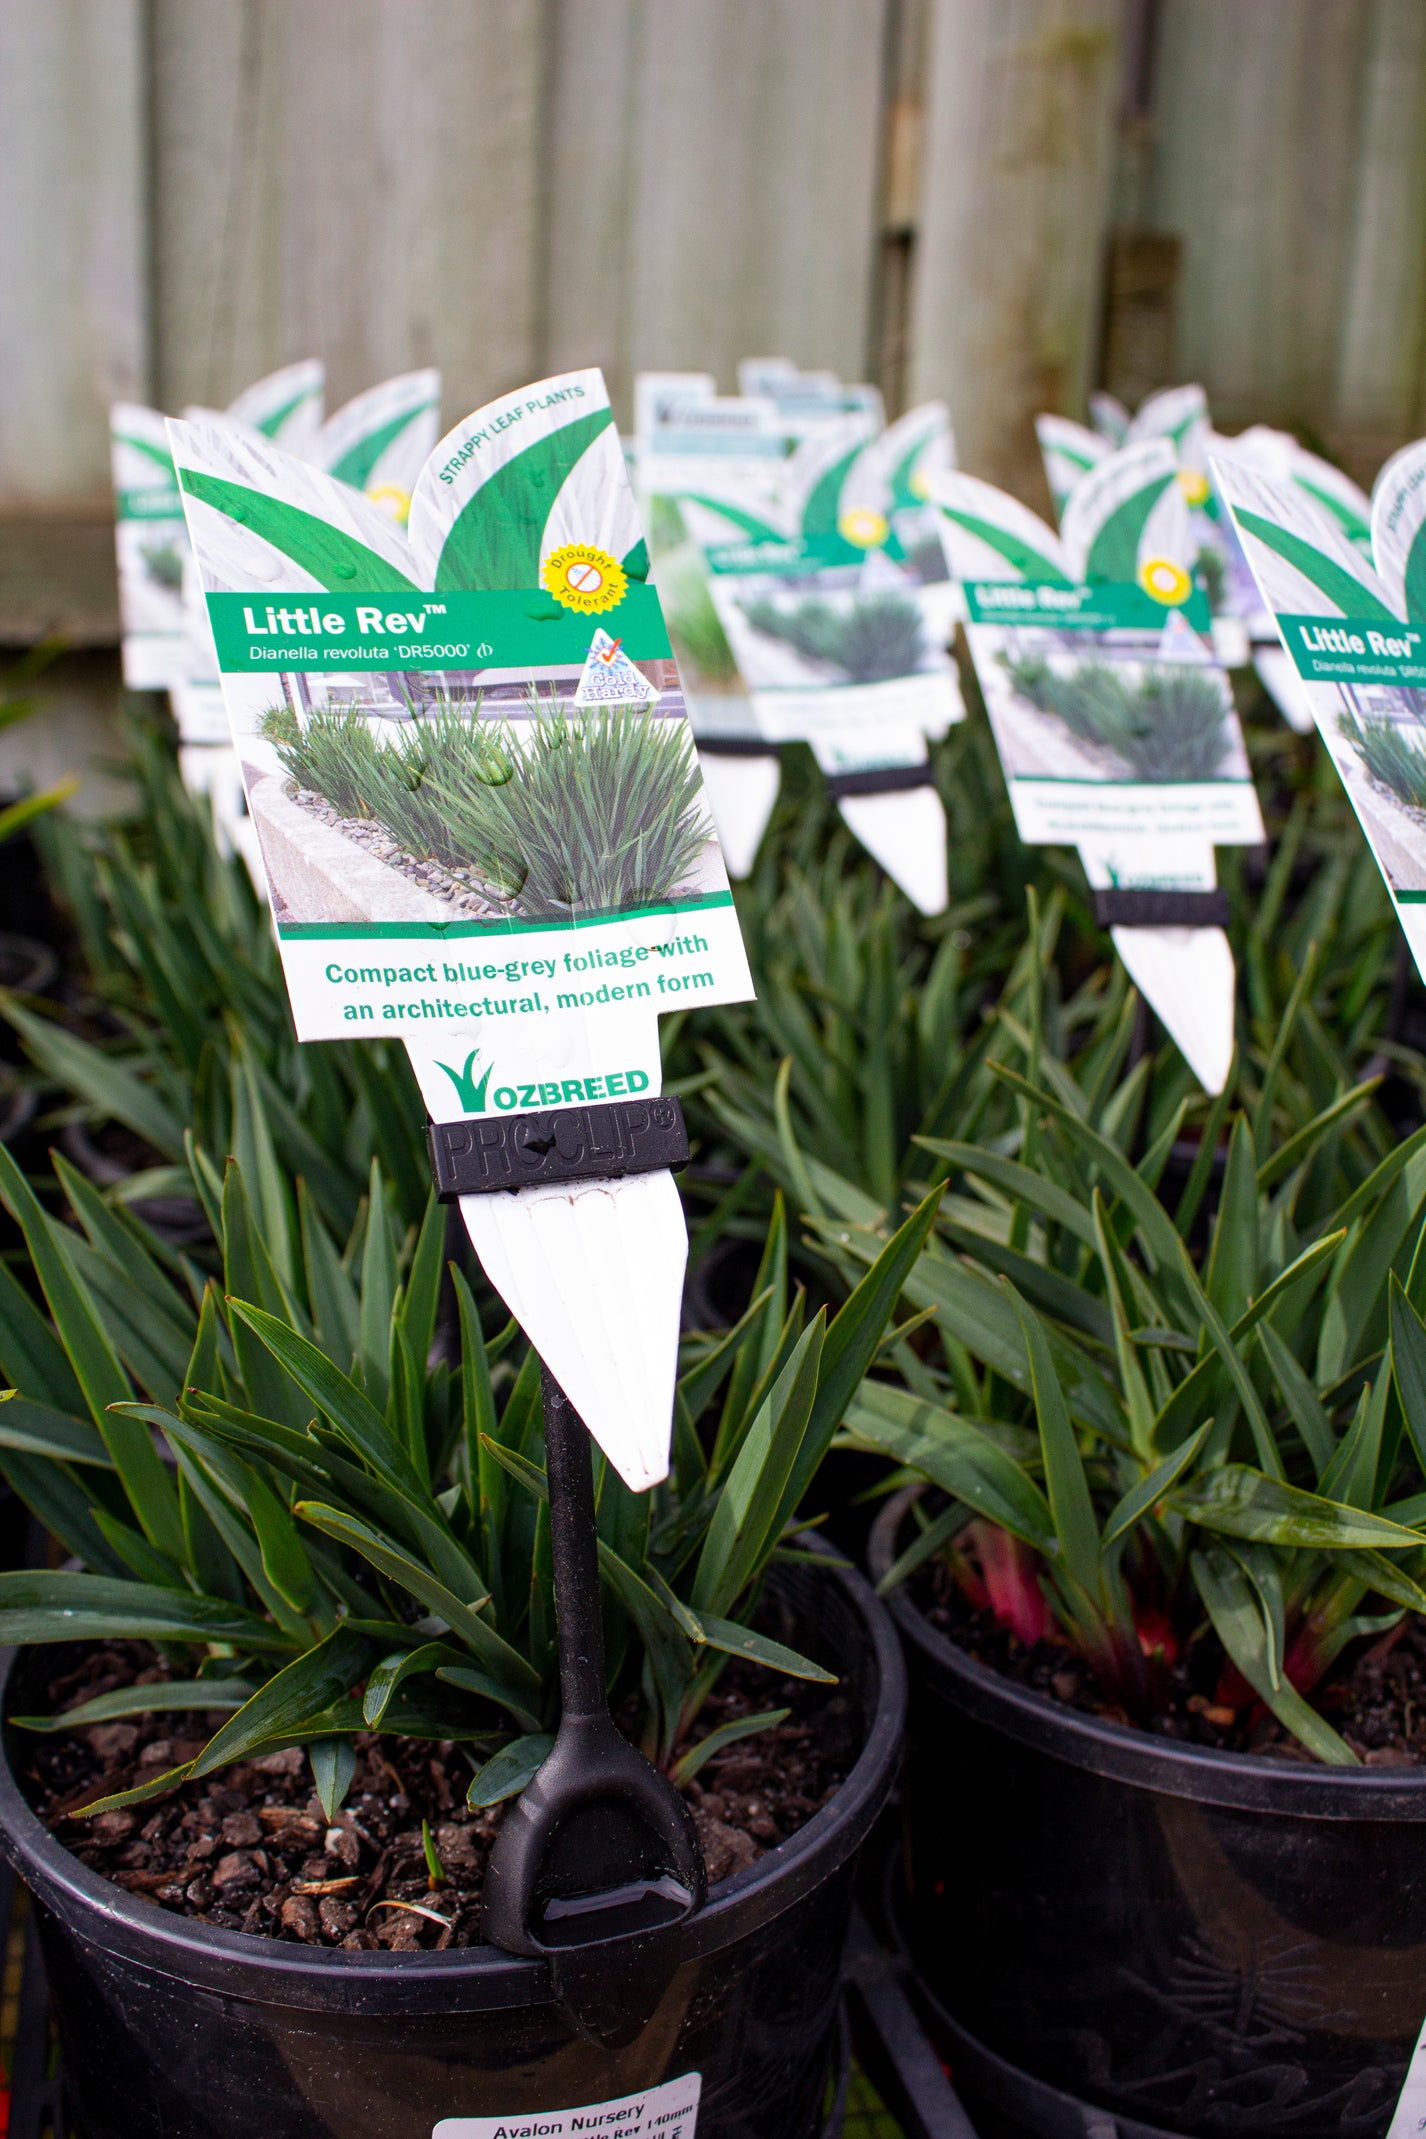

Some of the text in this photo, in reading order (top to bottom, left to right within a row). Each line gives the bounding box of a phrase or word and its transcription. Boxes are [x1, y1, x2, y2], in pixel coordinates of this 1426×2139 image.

[439, 386, 585, 485] STRAPPY LEAF PLANTS
[551, 550, 612, 569] Drought
[560, 583, 619, 606] Tolerant
[243, 606, 346, 634] Little
[250, 646, 318, 660] Dianella
[323, 645, 389, 660] revoluta
[1299, 625, 1366, 655] Little
[582, 684, 650, 701] Hardy
[590, 671, 639, 688] Cold
[325, 933, 709, 987] Compact blue-grey foliage with
[343, 972, 714, 1020] an architectural, modern form
[493, 1069, 651, 1111] OZBREED
[493, 2104, 645, 2139] Avalon Nursery
[647, 2104, 693, 2130] 140mm
